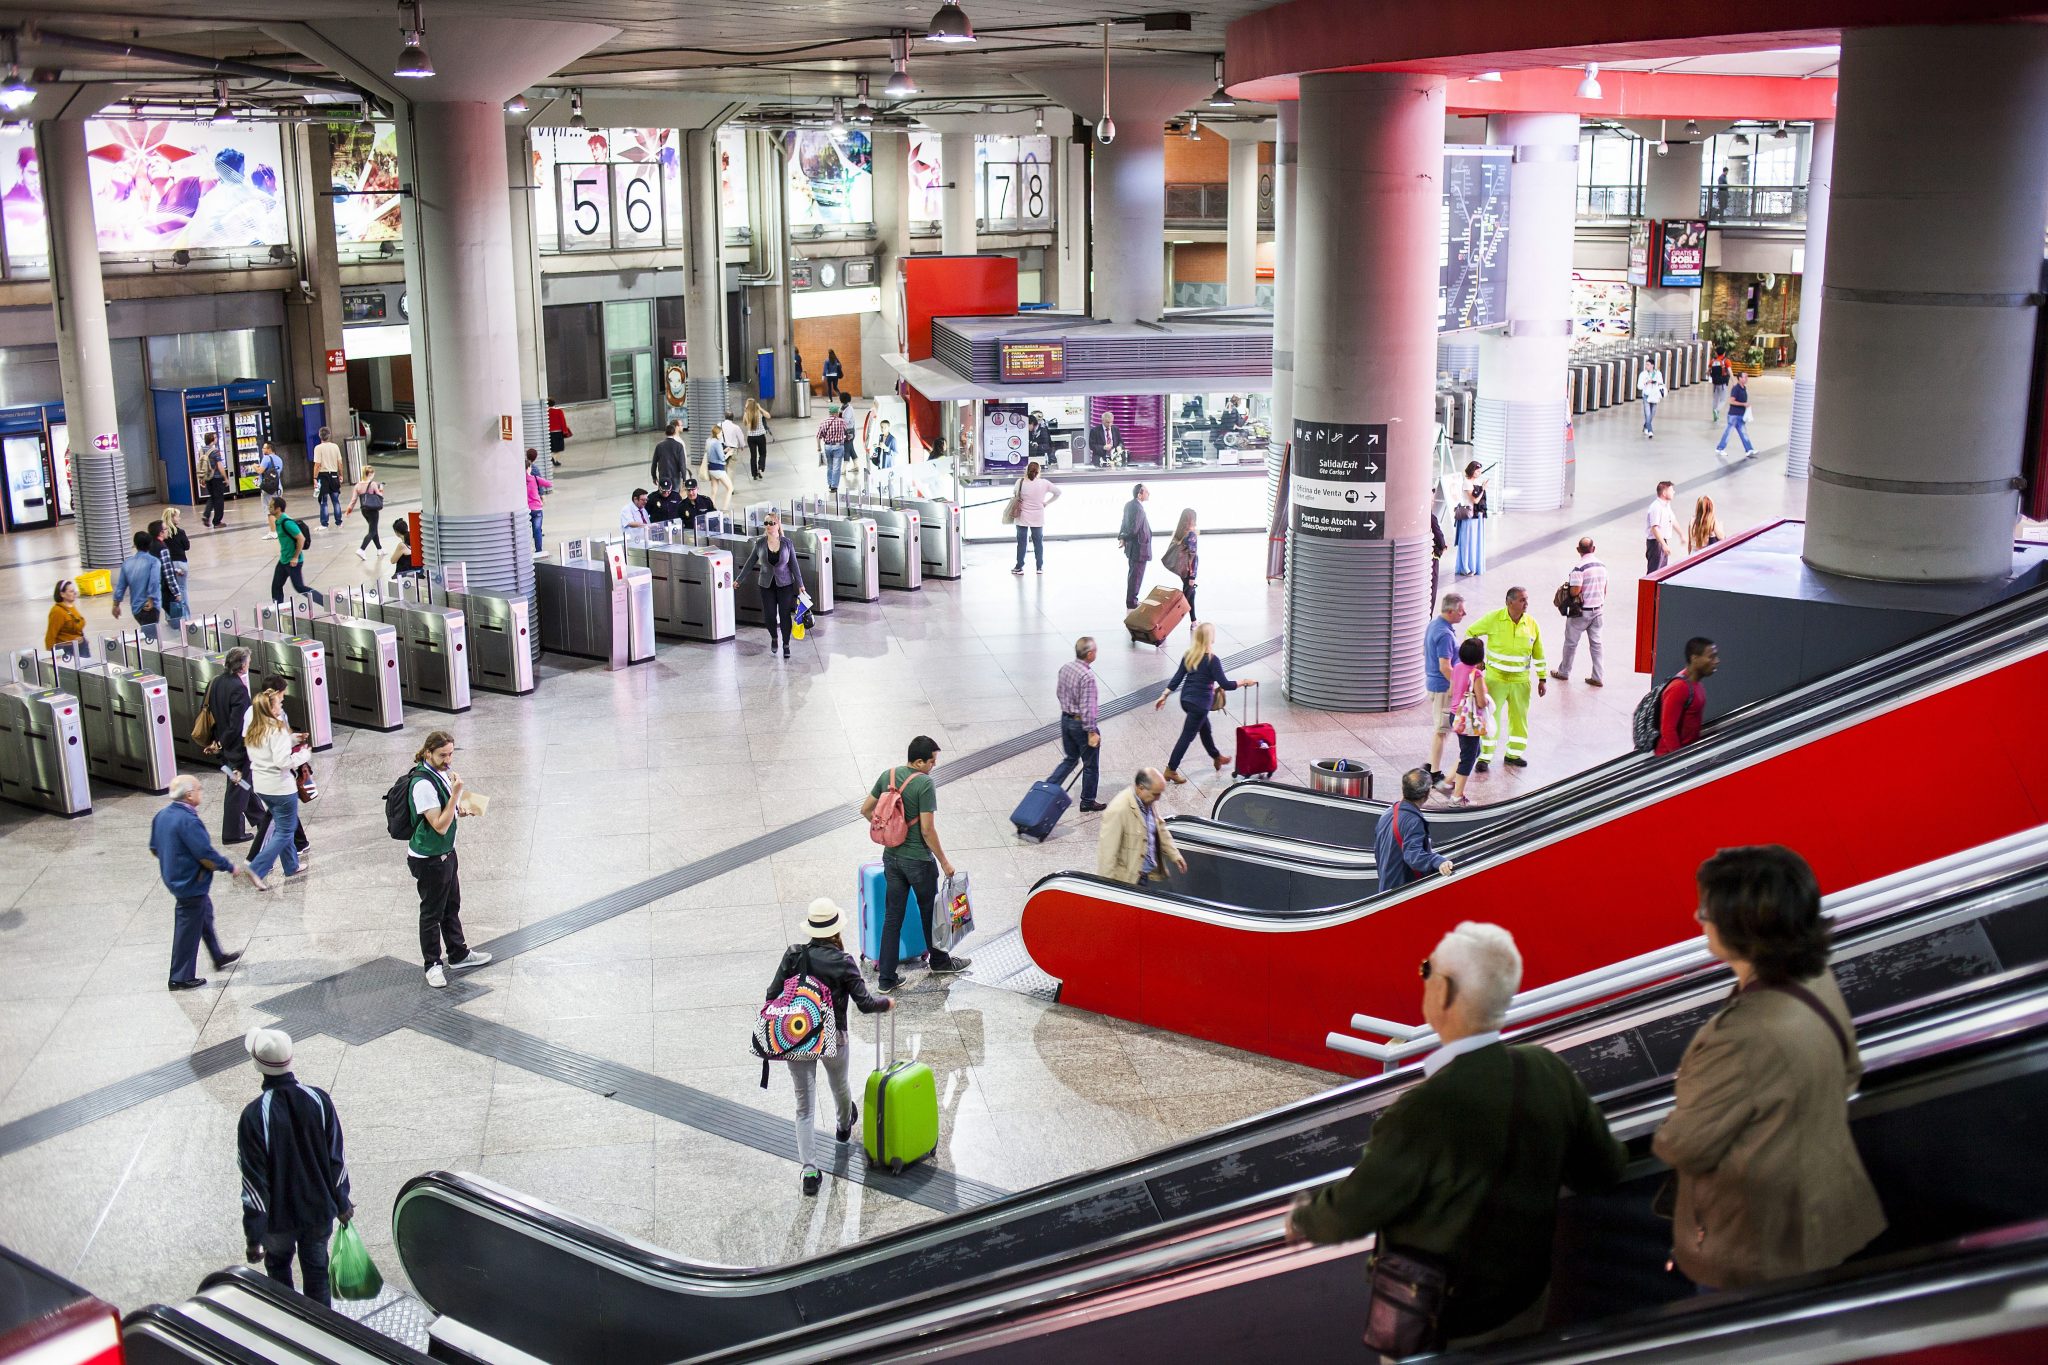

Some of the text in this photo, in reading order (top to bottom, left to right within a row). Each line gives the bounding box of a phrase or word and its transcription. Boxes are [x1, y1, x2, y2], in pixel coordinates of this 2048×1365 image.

[995, 174, 1043, 220] 7 8
[1260, 174, 1272, 211] 9
[573, 178, 652, 236] 5 6
[1670, 255, 1700, 264] DOBLE
[1319, 459, 1358, 469] Salida/Exit
[1296, 484, 1342, 497] Oficina de Venta
[1301, 513, 1357, 526] Puerta de Atocha
